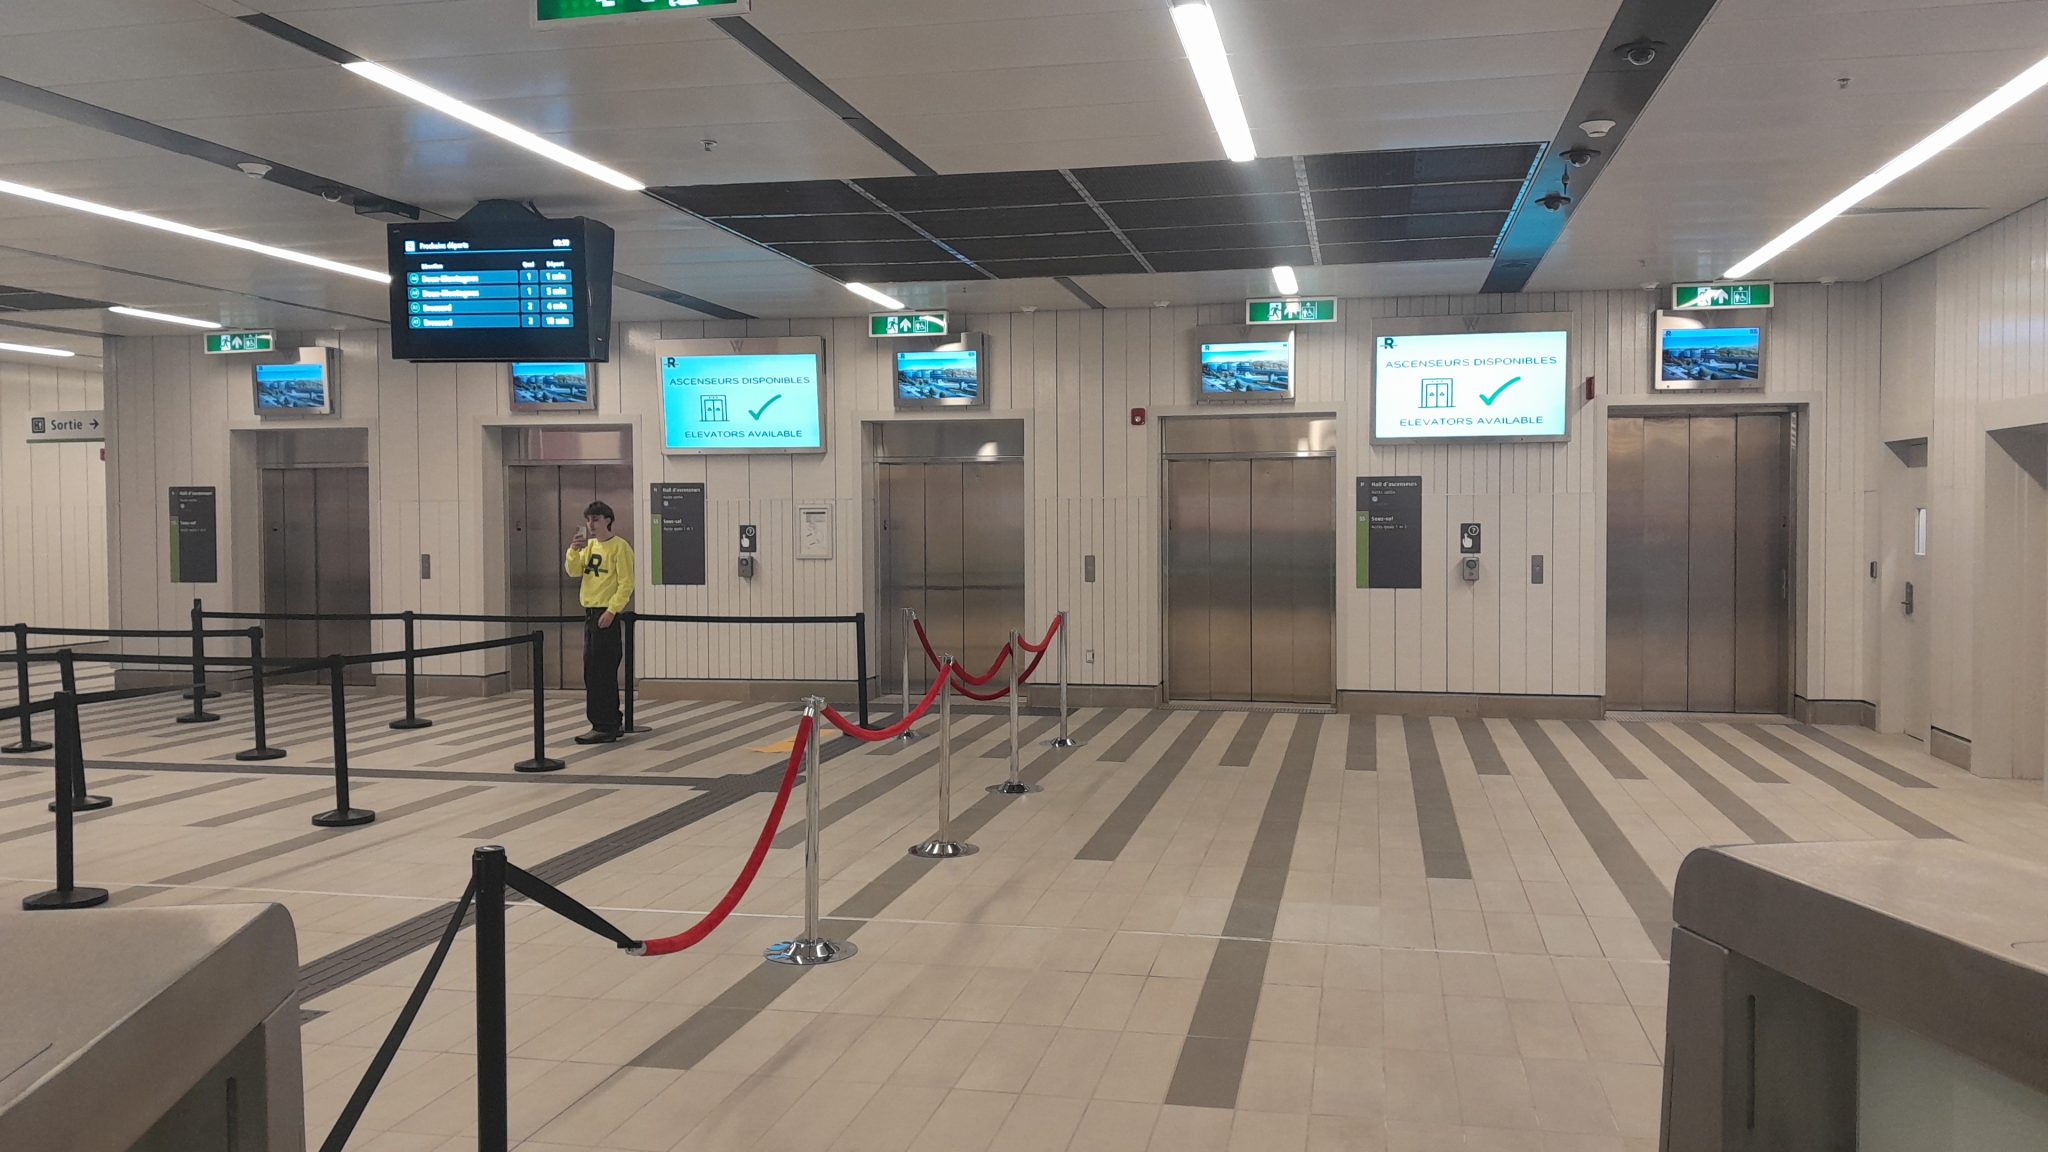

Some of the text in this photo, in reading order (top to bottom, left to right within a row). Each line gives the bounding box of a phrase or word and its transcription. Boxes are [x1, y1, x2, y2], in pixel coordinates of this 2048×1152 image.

[1384, 337, 1395, 349] R
[667, 357, 676, 368] R
[1385, 356, 1557, 368] ASCENSEURS DISPONIBLES
[669, 376, 810, 386] ASCENSEURS DISPONIBLES
[50, 419, 83, 430] Sortie
[1399, 416, 1544, 426] ELEVATORS AVAILABLE
[685, 430, 803, 439] ELEVATORS AVAILABLE
[585, 554, 602, 577] R
